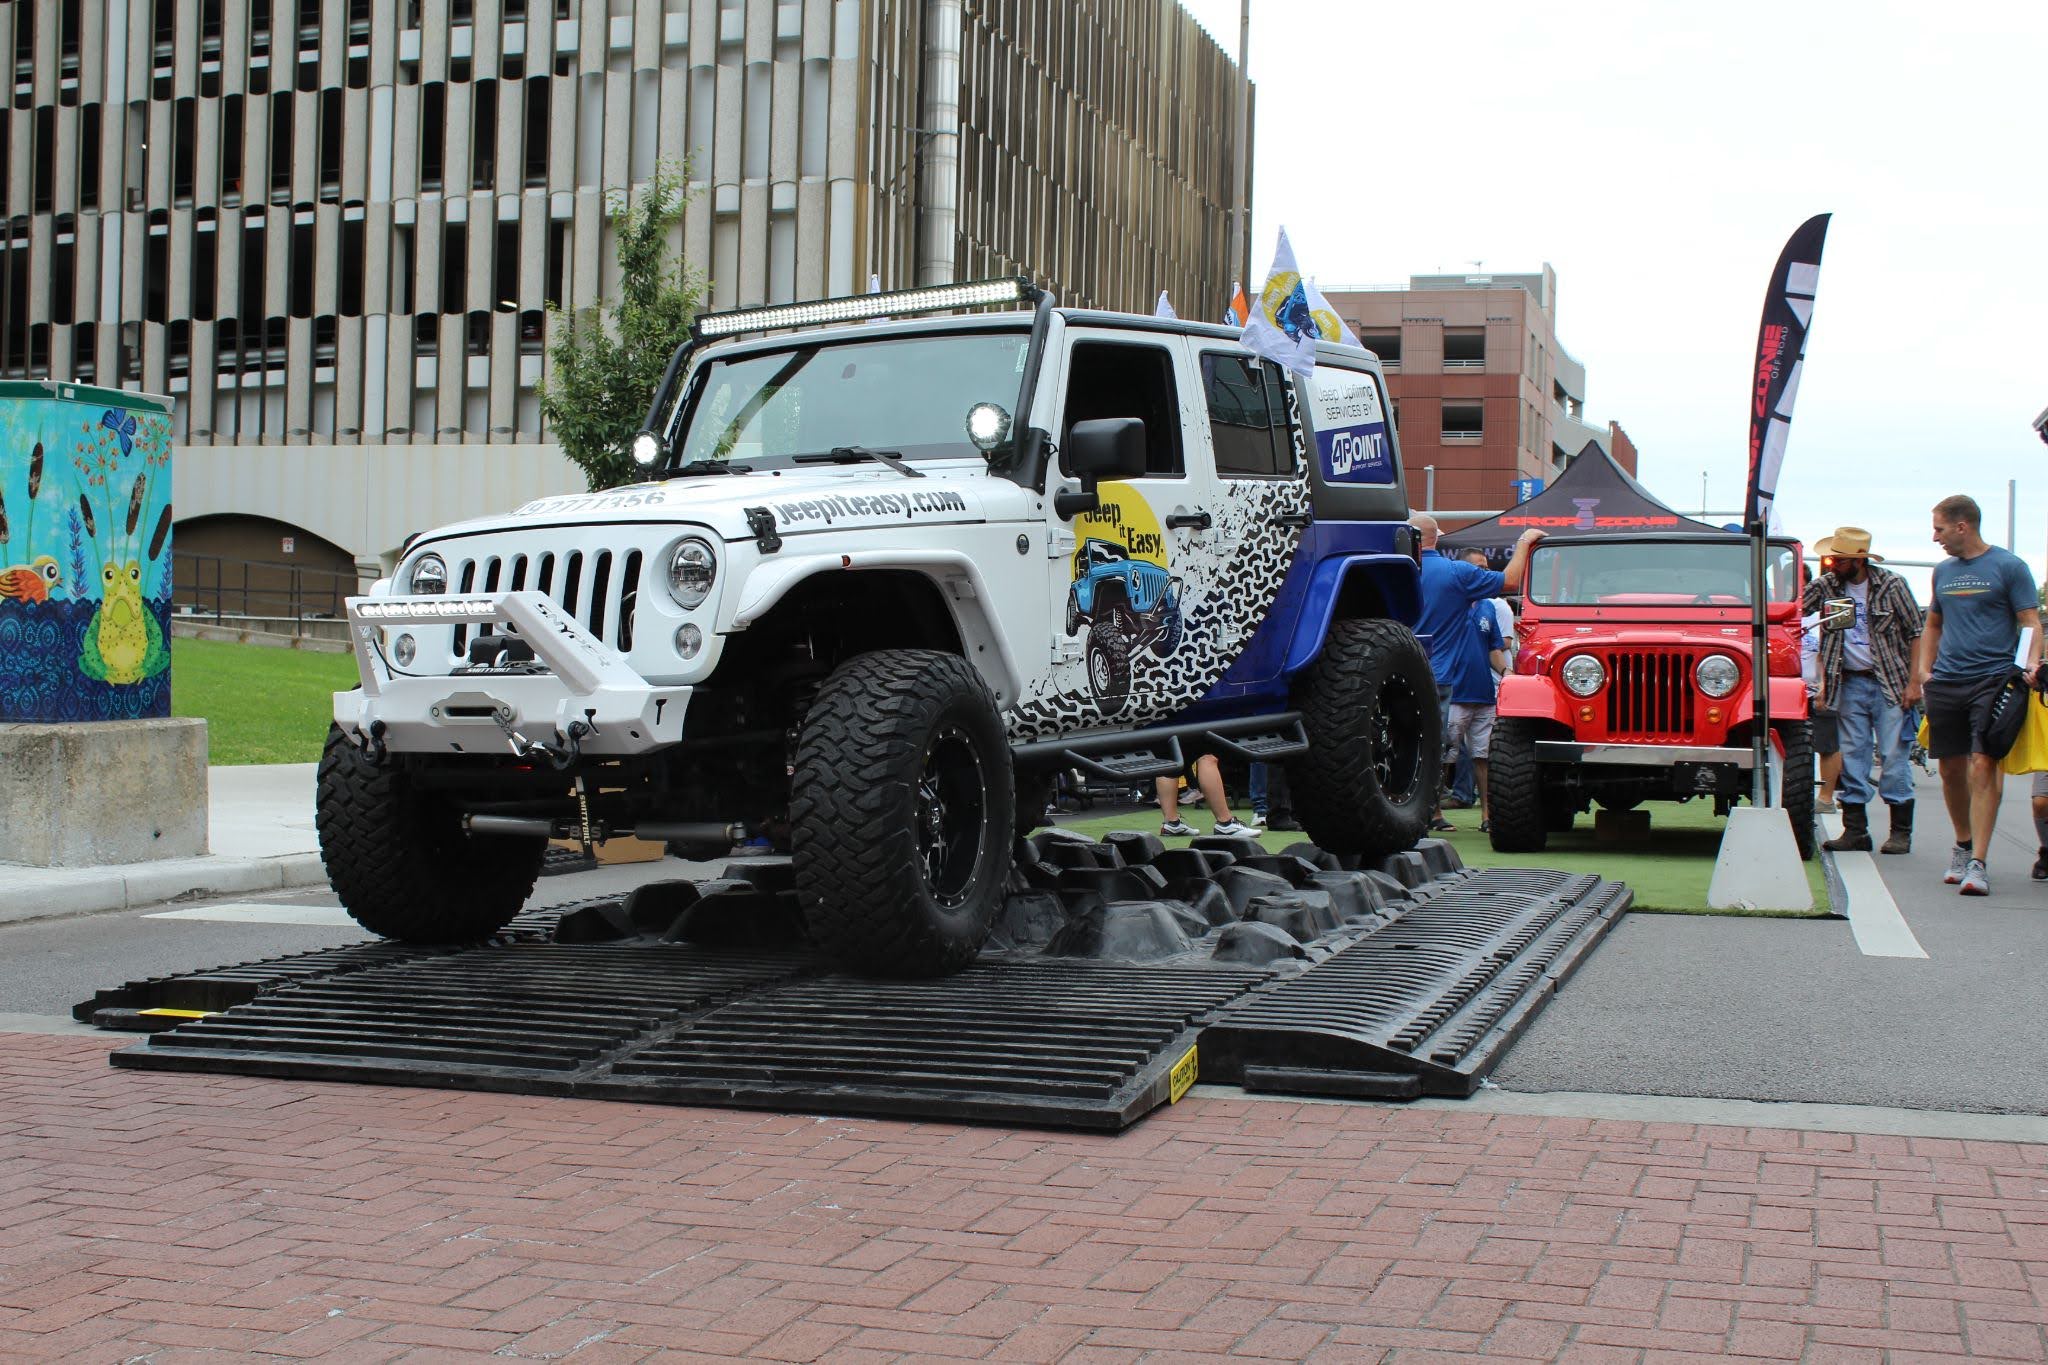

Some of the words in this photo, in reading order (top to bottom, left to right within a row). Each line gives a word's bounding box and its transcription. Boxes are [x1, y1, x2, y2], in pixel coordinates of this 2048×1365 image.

[1776, 326, 1789, 356] ROAD
[1755, 325, 1783, 418] ZONE
[1771, 359, 1782, 379] OFF
[1318, 386, 1340, 404] Jeep
[1326, 404, 1362, 420] SERVICES
[1363, 403, 1373, 416] BY
[1332, 432, 1382, 470] 4POINT
[773, 491, 967, 526] jeepiteasy.com
[1119, 524, 1126, 538] it
[1498, 516, 1582, 527] DROP
[1594, 516, 1678, 526] ZONE
[579, 794, 590, 846] SMITTYBILT
